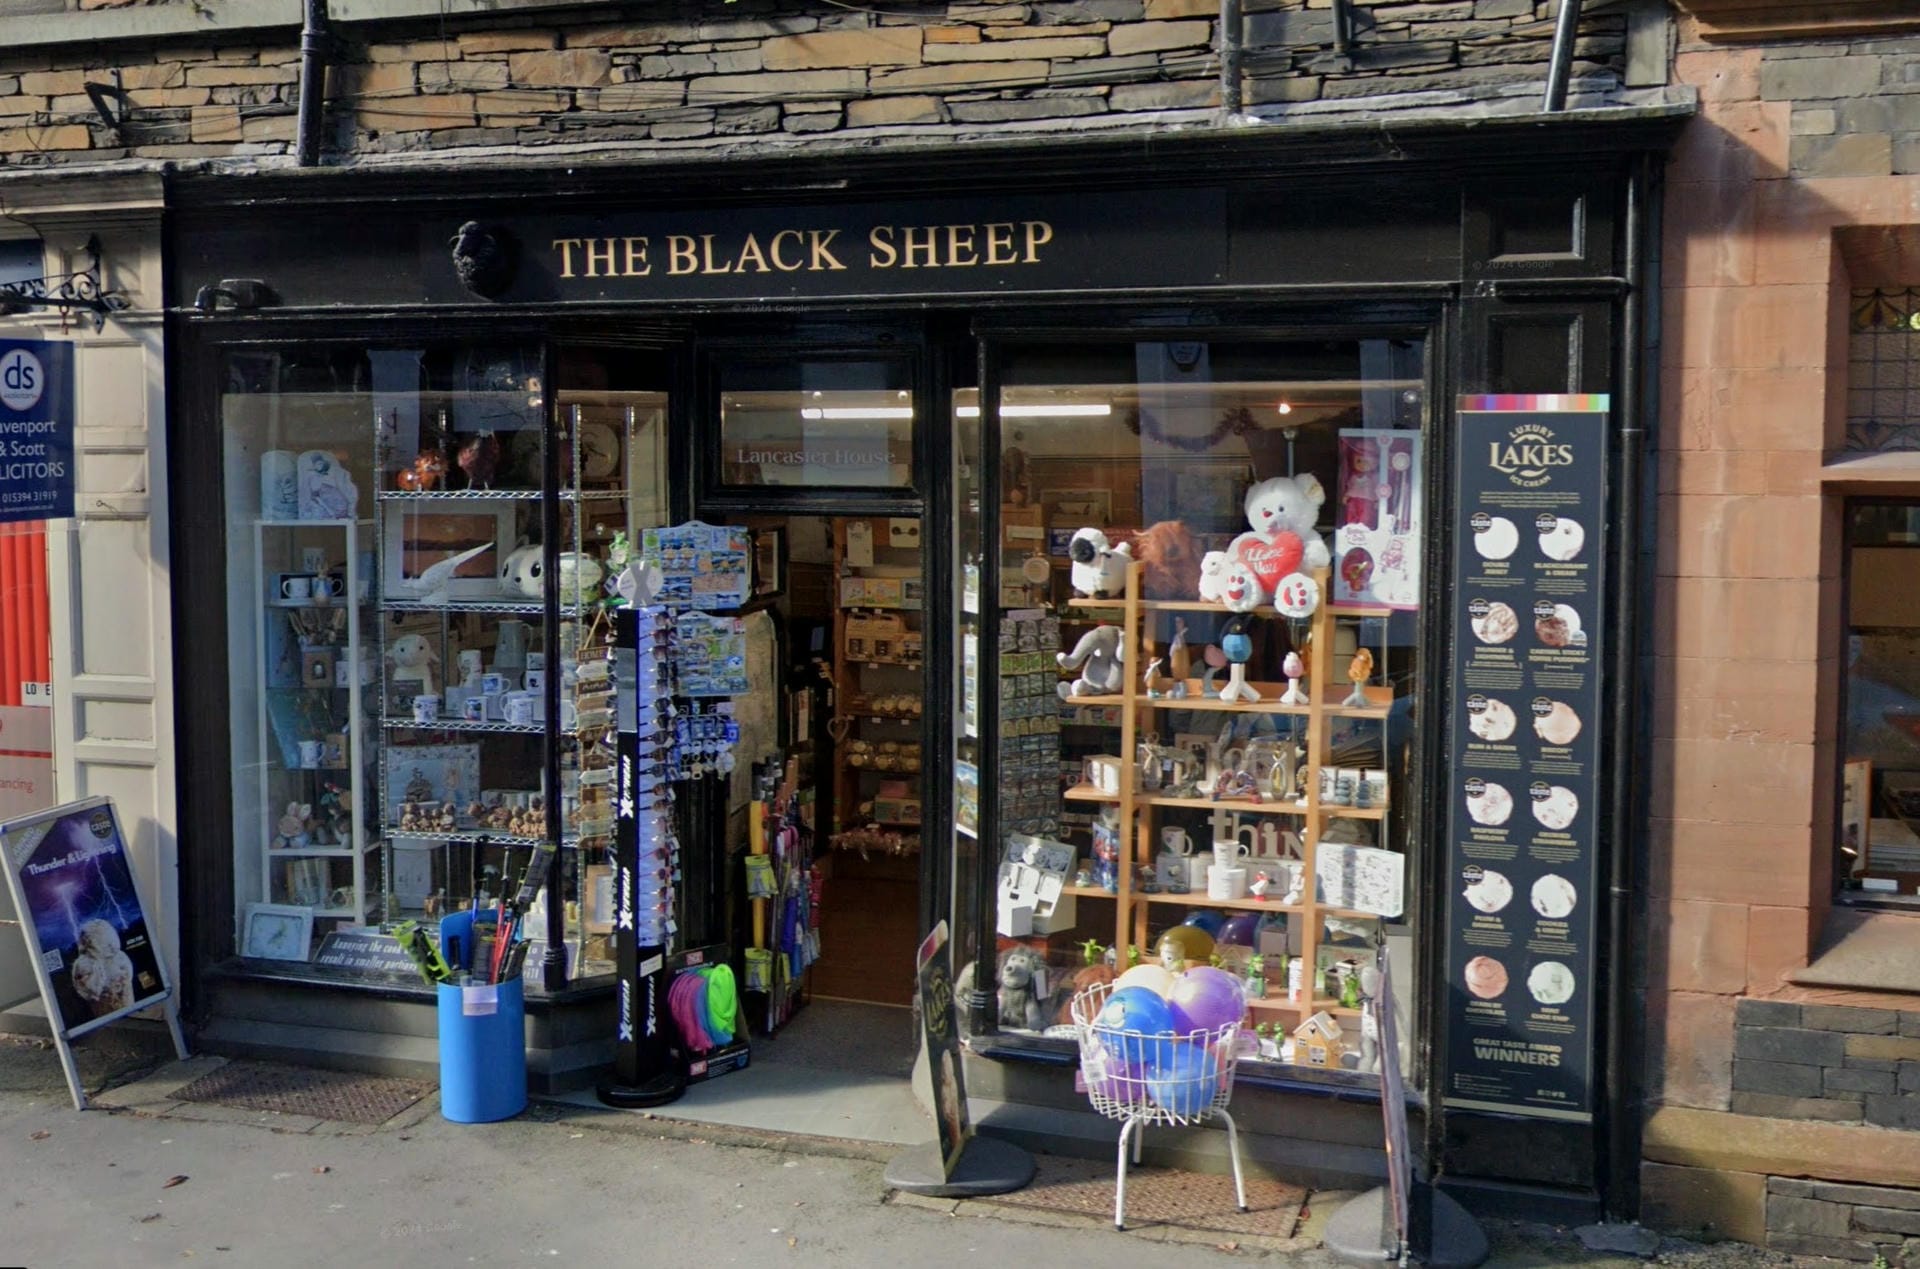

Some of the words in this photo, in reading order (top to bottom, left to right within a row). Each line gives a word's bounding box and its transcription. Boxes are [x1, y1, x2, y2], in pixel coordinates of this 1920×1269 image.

[552, 236, 652, 278] THE
[666, 229, 848, 275] BLACK
[869, 221, 1053, 269] SHEEP
[5, 354, 35, 390] ds
[1508, 424, 1555, 438] LUXURY
[11, 440, 45, 457] Scott
[737, 449, 827, 464] Lancaster
[835, 449, 896, 464] House
[1488, 441, 1574, 474] LAKES
[0, 462, 65, 480] LICITORS
[27, 856, 67, 876] Thunder
[74, 844, 118, 863] Ligning
[332, 937, 369, 953] Annoying
[369, 940, 381, 953] the
[320, 953, 345, 965] result
[354, 954, 385, 968] smaller
[1473, 1038, 1501, 1047] GREAT
[1474, 1046, 1561, 1067] WINNERS
